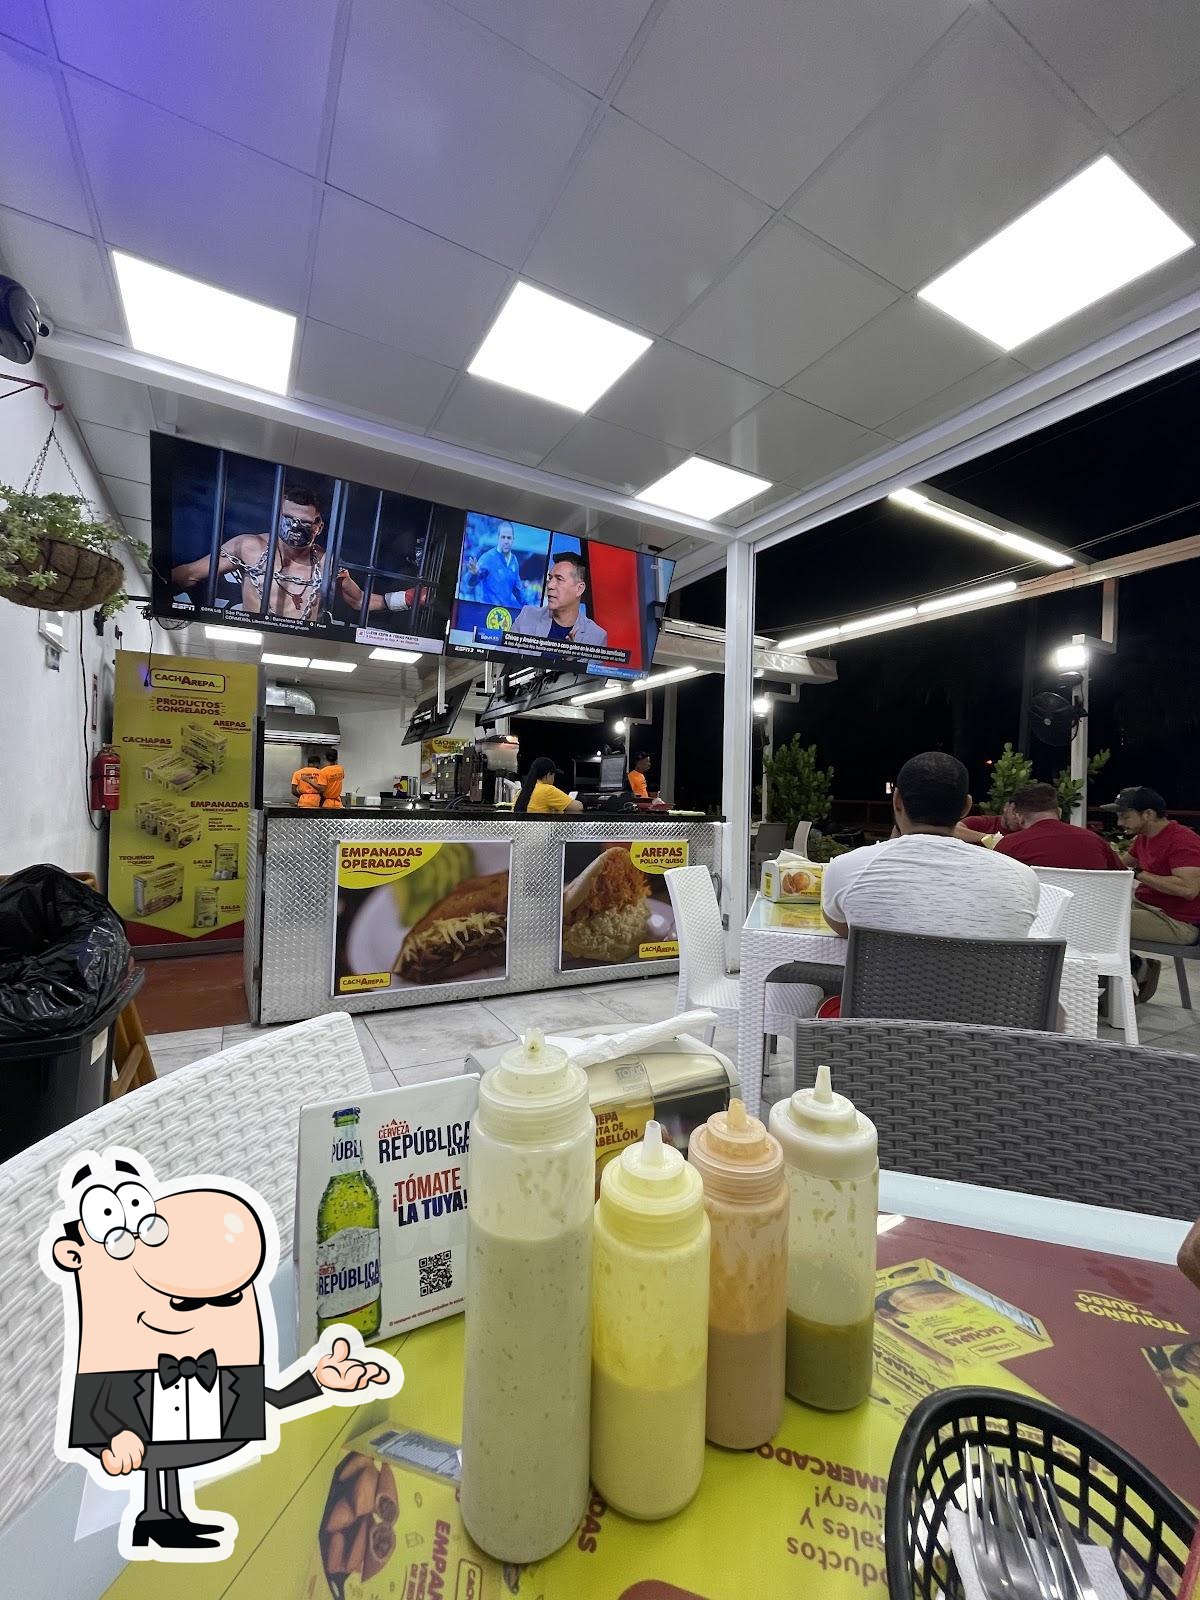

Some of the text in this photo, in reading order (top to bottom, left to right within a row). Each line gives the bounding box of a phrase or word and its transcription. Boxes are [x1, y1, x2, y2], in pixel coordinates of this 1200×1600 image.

[172, 602, 195, 611] ESPN
[522, 636, 540, 645] América
[154, 673, 216, 688] CACHAREPA
[156, 697, 220, 709] PRODUCTOS
[156, 705, 221, 716] CONGELADOS
[213, 720, 247, 728] AREPAS
[121, 736, 172, 745] CACHAPAS
[190, 800, 250, 809] EMPANADAS
[341, 847, 423, 858] EMPANADAS
[641, 847, 683, 858] AREPAS
[341, 858, 411, 868] OPERADAS
[641, 945, 676, 954] CACHAREPA
[342, 977, 384, 986] CACHAREPA
[378, 1124, 410, 1140] CERVEZA
[612, 1121, 624, 1132] DE
[393, 1167, 462, 1213] ¡TÓMATE
[397, 1189, 468, 1228] LA TUYA!
[318, 1259, 380, 1296] REPÚBLICA
[1078, 1293, 1138, 1313] QUESO
[1074, 1301, 1190, 1335] TEQUEÑOS
[943, 1325, 1006, 1347] CACHAPAS
[800, 1507, 815, 1530] y
